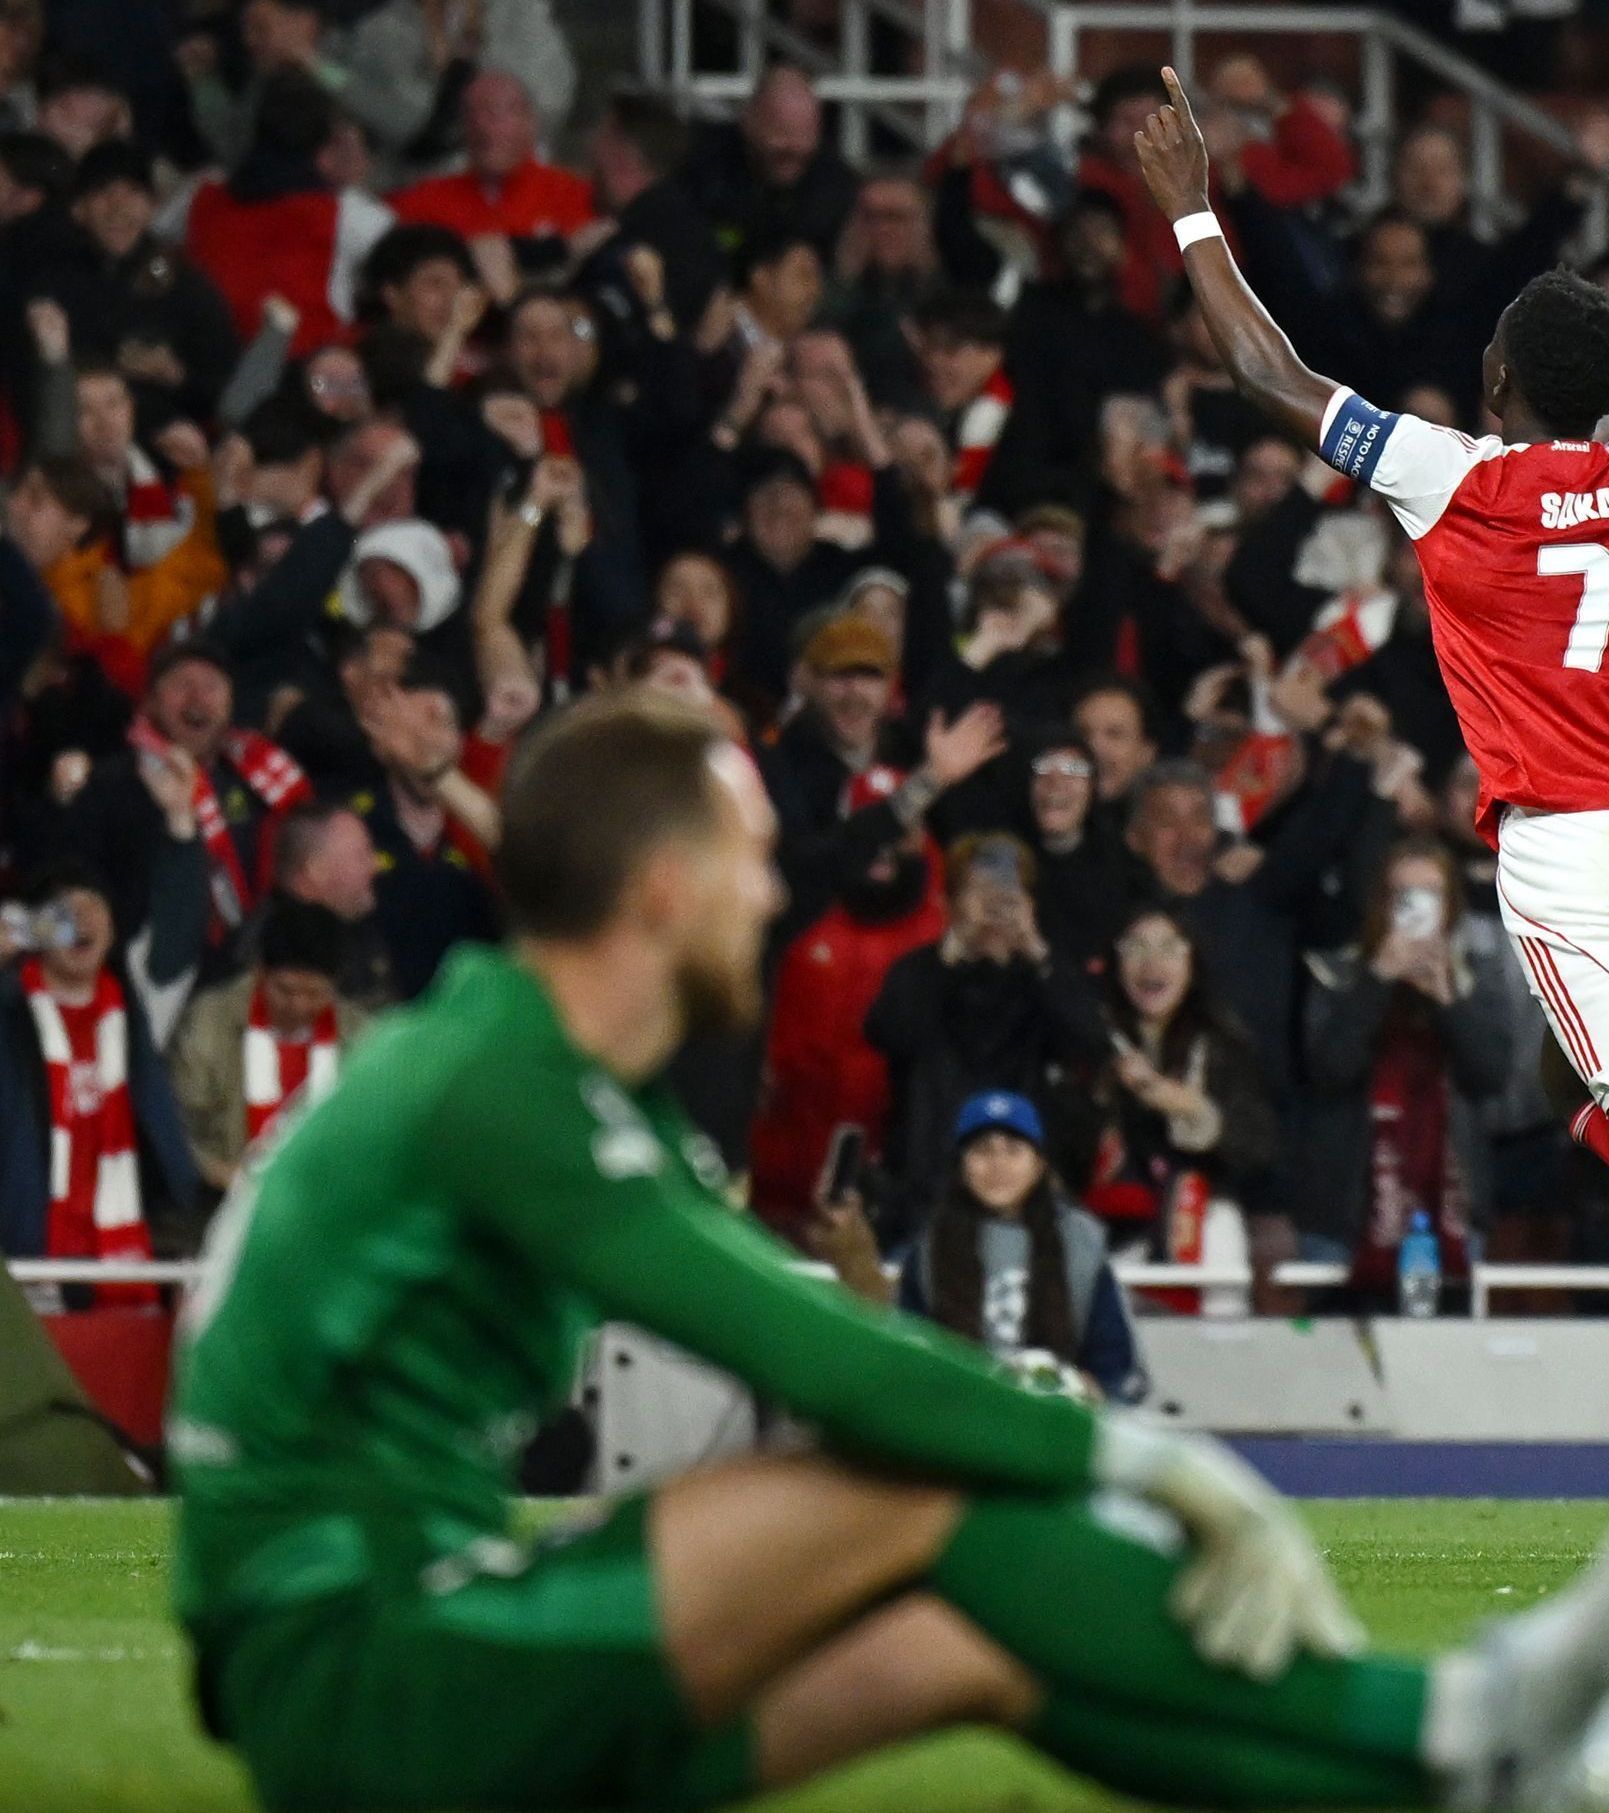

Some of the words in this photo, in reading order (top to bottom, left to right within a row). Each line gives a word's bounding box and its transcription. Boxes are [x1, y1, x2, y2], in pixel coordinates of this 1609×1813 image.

[1366, 423, 1381, 441] NO
[1333, 434, 1354, 474] RESPEC
[1359, 440, 1373, 456] TO
[1350, 454, 1365, 479] RAC
